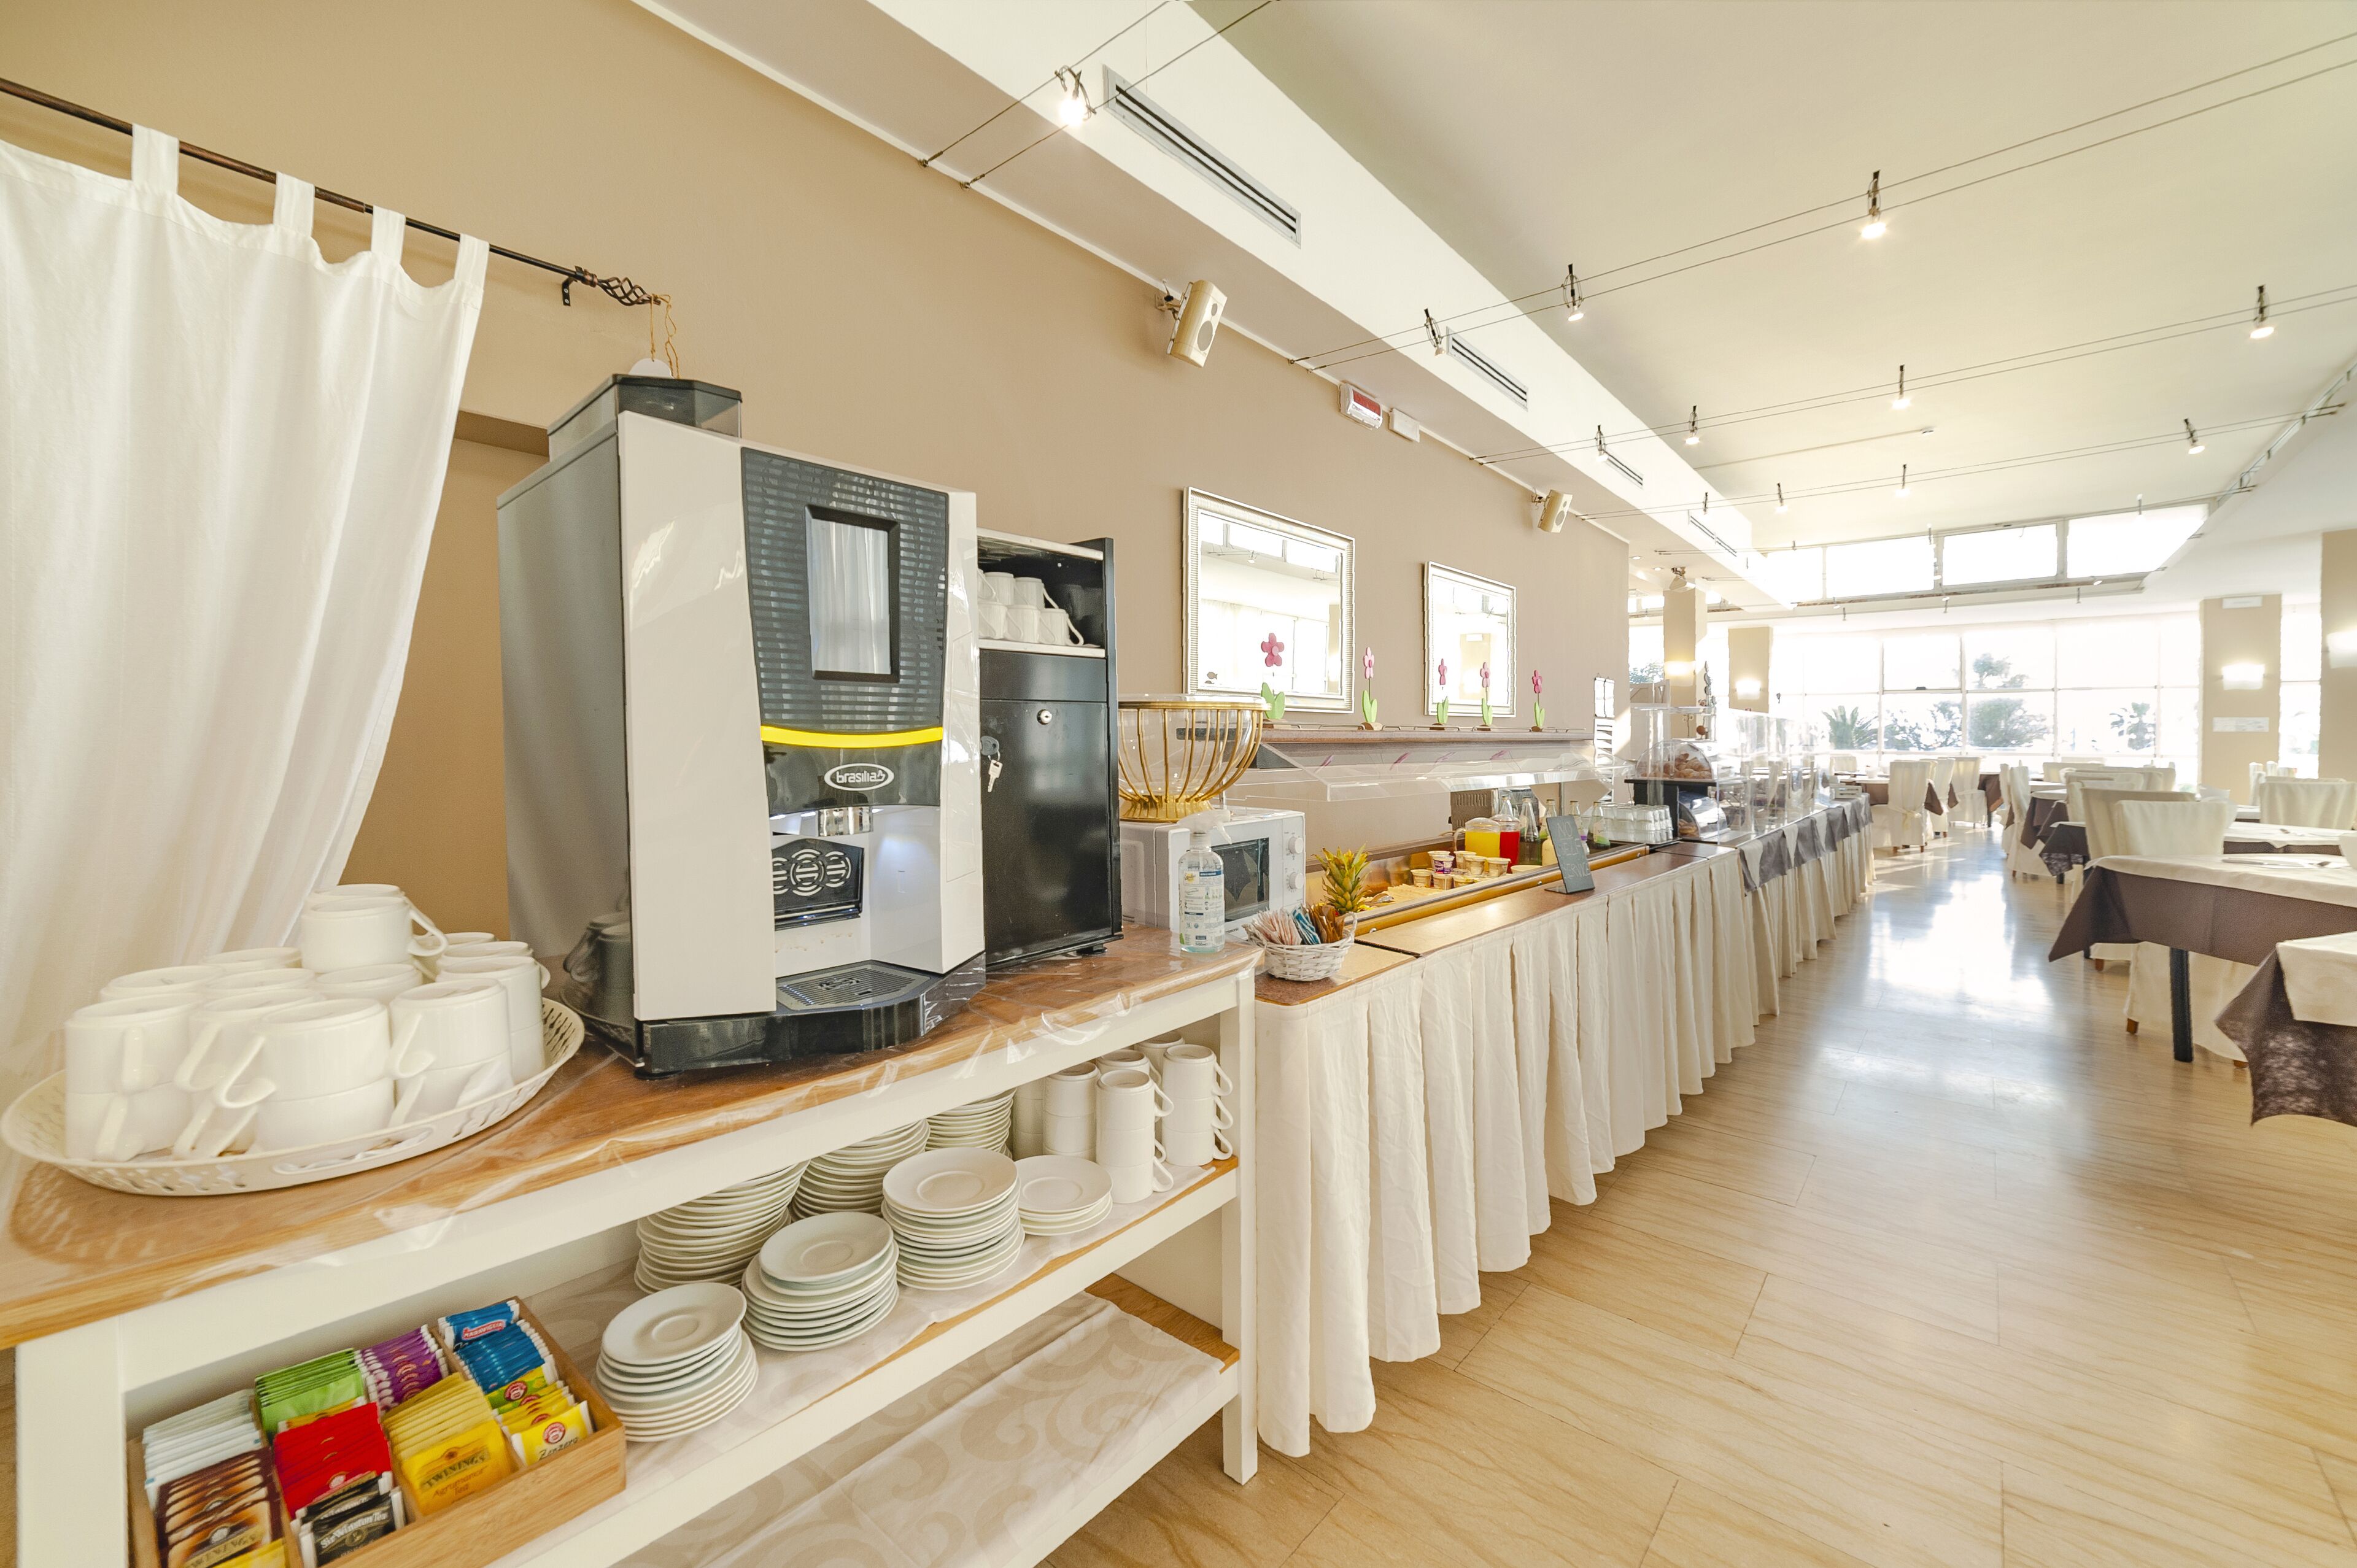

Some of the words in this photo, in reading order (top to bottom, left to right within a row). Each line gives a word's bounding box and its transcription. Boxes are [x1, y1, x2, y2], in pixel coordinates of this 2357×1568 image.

[836, 770, 885, 783] brasilia
[1557, 821, 1573, 837] NO
[422, 1455, 486, 1488] TWININGS
